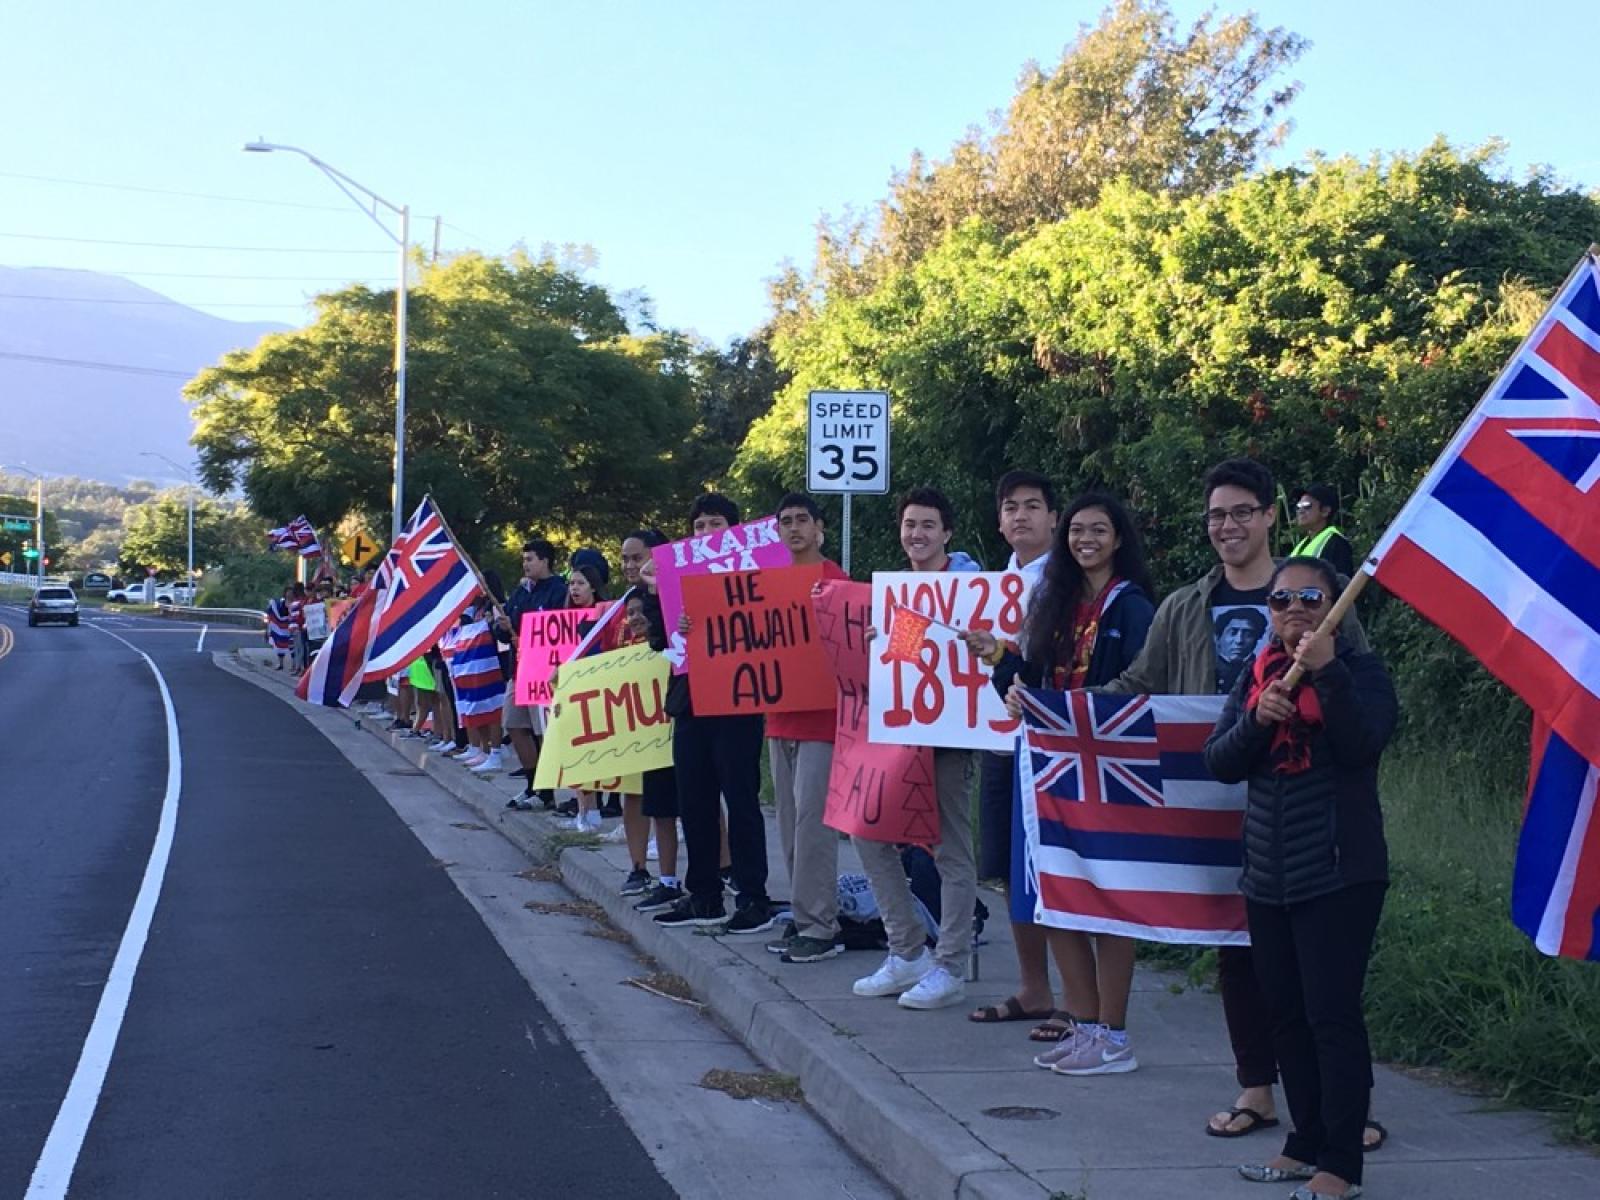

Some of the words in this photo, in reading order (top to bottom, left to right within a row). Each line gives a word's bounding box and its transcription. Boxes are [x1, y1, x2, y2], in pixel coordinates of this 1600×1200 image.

[816, 402, 882, 418] SPEED
[823, 423, 874, 439] LIMIT
[818, 444, 879, 481] 35
[724, 571, 765, 608] HE
[733, 659, 783, 707] AU
[569, 677, 671, 748] IMU
